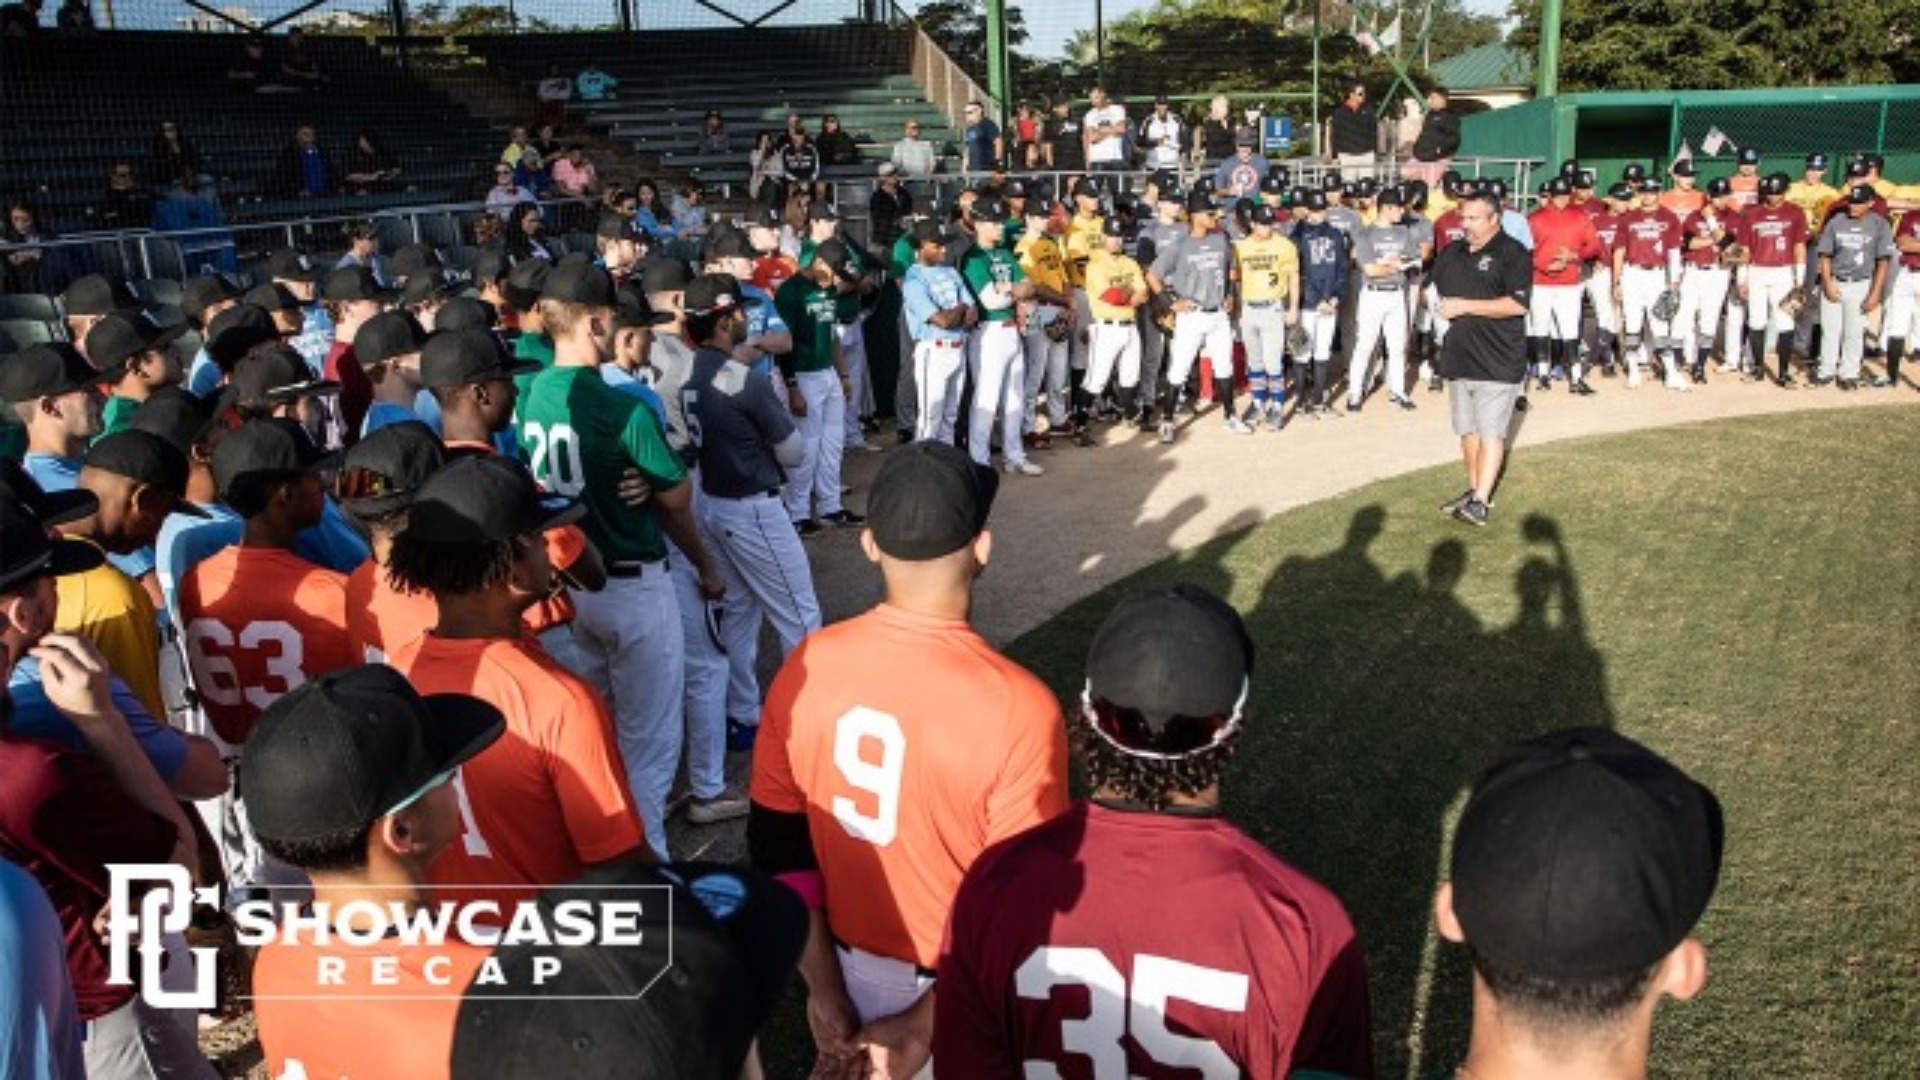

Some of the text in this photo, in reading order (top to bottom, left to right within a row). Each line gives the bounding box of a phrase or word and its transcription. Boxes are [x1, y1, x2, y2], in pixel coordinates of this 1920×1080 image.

[524, 420, 586, 497] 20
[187, 617, 309, 710] 63
[833, 705, 907, 847] 9
[1014, 945, 1250, 1080] 35
